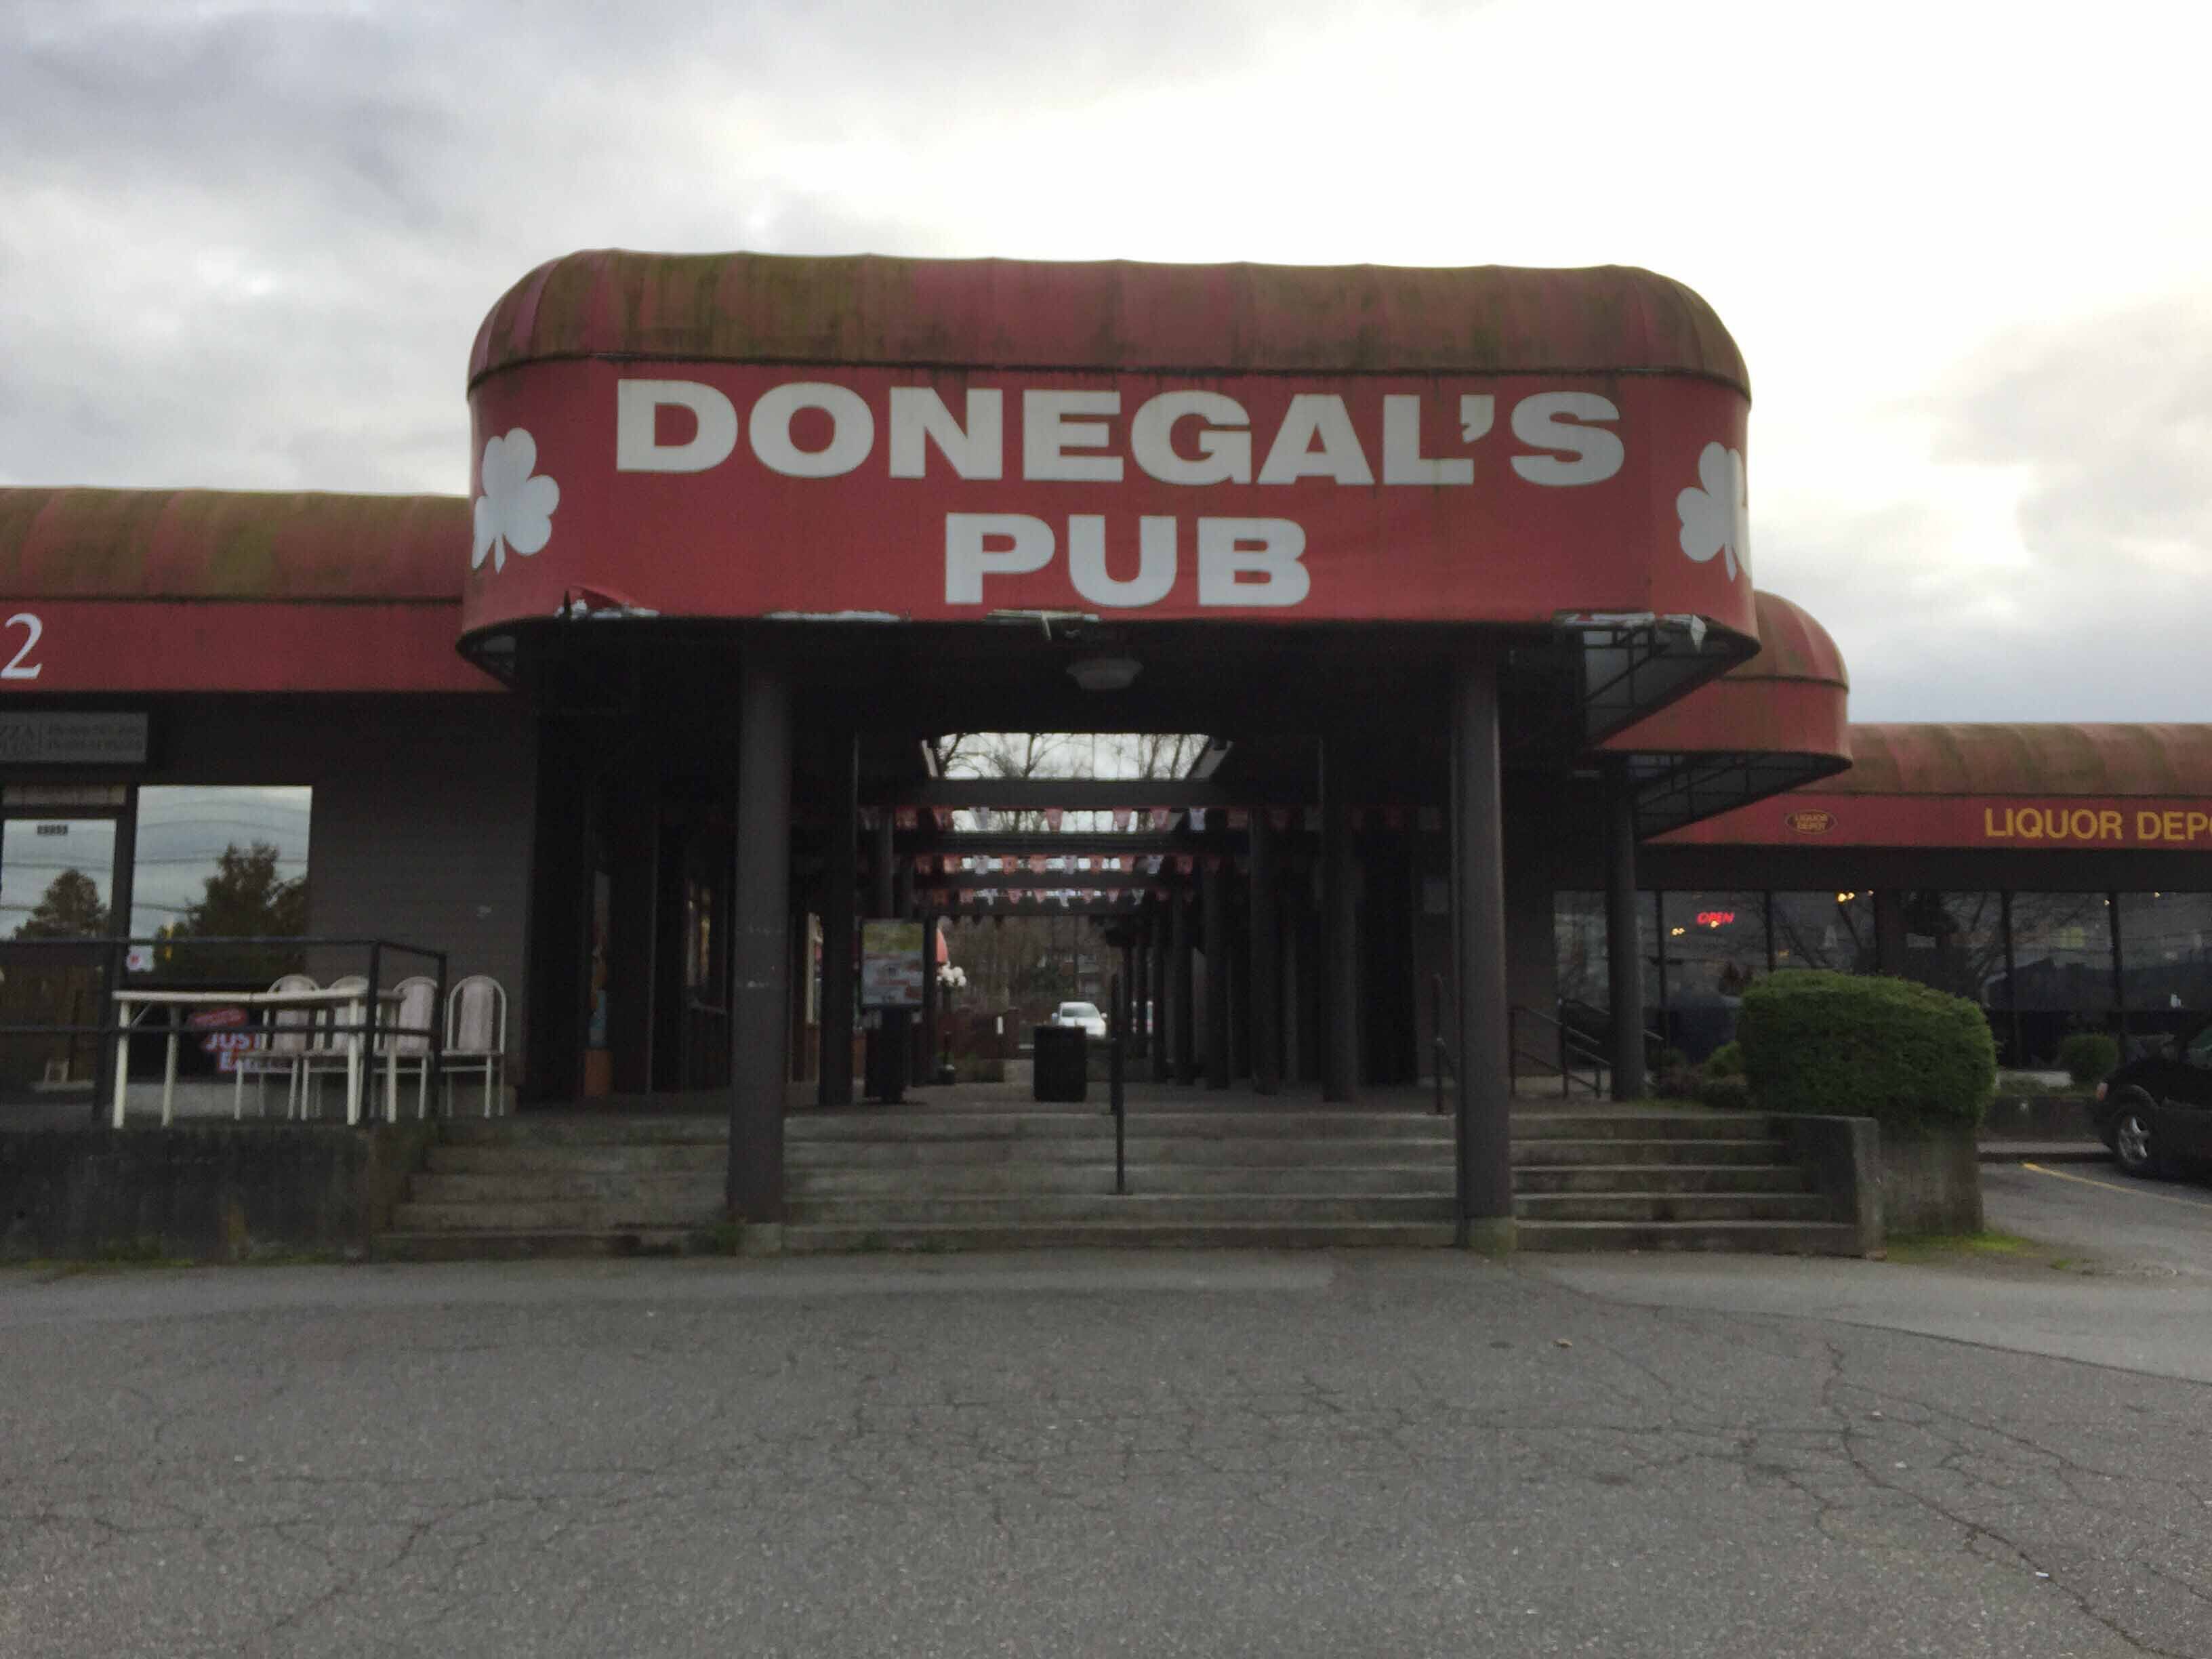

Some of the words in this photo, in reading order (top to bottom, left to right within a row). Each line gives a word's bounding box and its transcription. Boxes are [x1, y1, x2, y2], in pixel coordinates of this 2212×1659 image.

[616, 377, 1625, 487] DONEGAL'S
[945, 512, 1311, 608] PUB
[0, 613, 43, 679] 2
[1984, 807, 2124, 840] LIQUOR
[2136, 811, 2212, 841] DEP
[1696, 912, 1735, 926] OPEN
